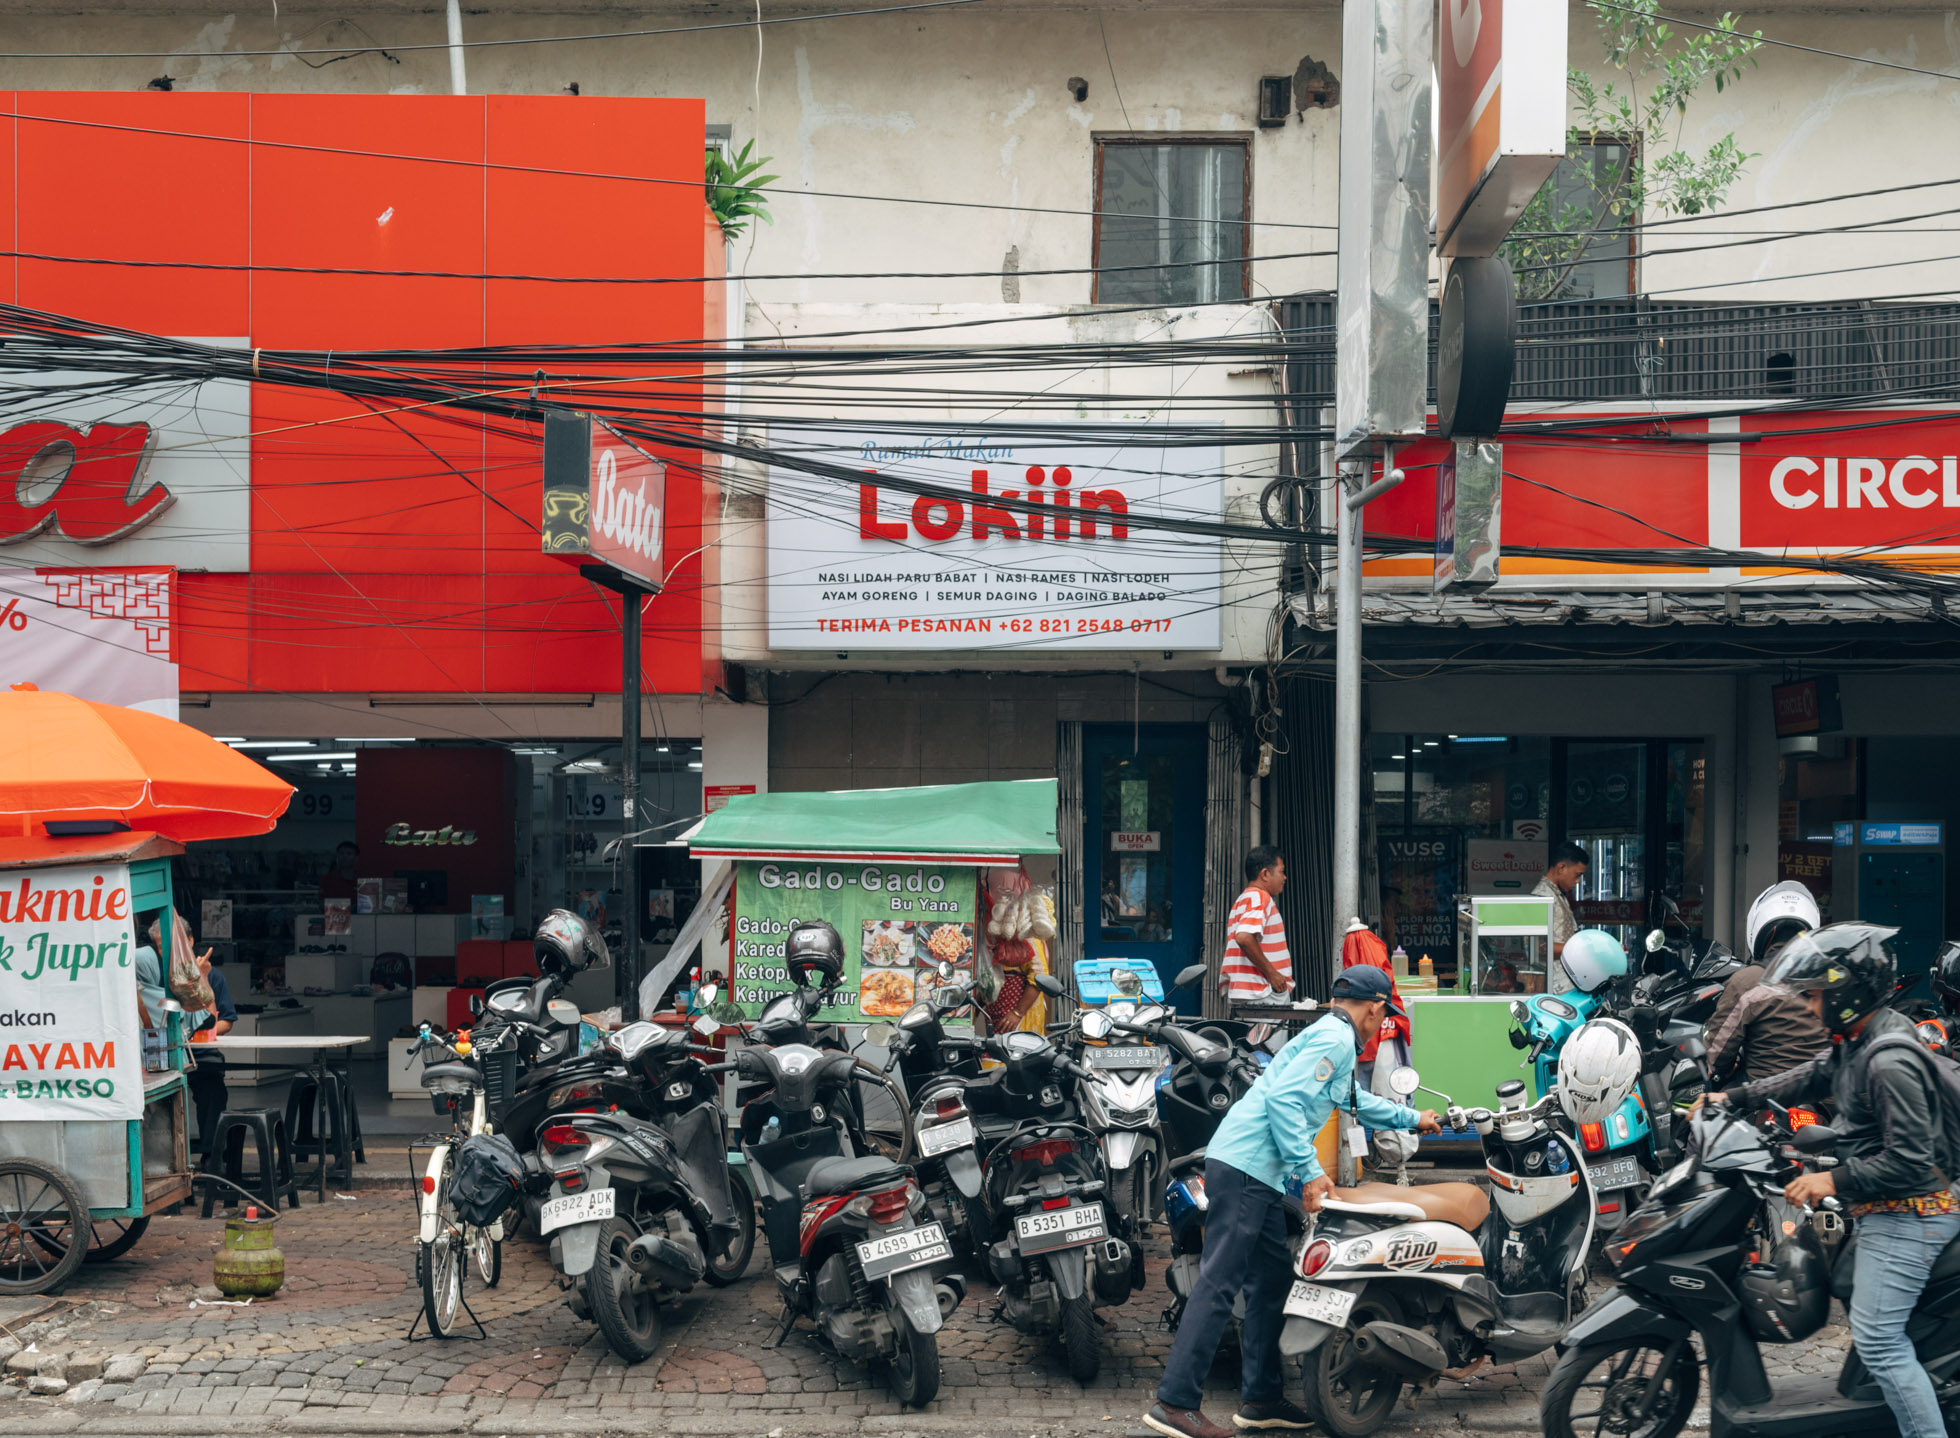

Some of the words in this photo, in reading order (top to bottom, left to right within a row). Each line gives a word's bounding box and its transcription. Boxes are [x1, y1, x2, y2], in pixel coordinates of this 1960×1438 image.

[592, 449, 662, 561] Bata
[860, 465, 1128, 541] Lokiin
[819, 573, 849, 582] NASI
[854, 573, 892, 583] LIDAH
[897, 573, 931, 583] PARU
[936, 573, 977, 582] BABAT
[996, 573, 1027, 583] NASI
[1031, 573, 1076, 583] RAMES
[1092, 573, 1122, 583] NASI
[1127, 573, 1170, 583] LODEH
[822, 591, 857, 601] AYAM
[862, 591, 918, 601] GORENG
[937, 591, 981, 601] SEMUR
[986, 591, 1038, 601] DAGING
[1057, 591, 1108, 601] DAGING
[1112, 592, 1166, 601] BALADO
[817, 619, 891, 632] TERIMA
[898, 619, 991, 632] PESANAN
[999, 619, 1032, 632] +62
[1040, 619, 1070, 632] 821
[1077, 619, 1123, 632] 2548
[1131, 619, 1172, 632] 0717
[303, 794, 333, 816] 99
[379, 822, 478, 846] Bata
[1118, 834, 1153, 843] BUKA
[1472, 860, 1508, 871] Sweet
[1510, 861, 1545, 872] Deals
[1785, 864, 1822, 877] FREE
[1795, 854, 1804, 864] 2
[1807, 855, 1832, 866] GET
[759, 864, 945, 893] Gado-Gado
[891, 897, 913, 910] Bu
[918, 898, 959, 912] Yana
[1423, 924, 1451, 934] NO.1
[21, 932, 131, 981] Jupri
[3, 1042, 115, 1070] AYAM
[1095, 1050, 1102, 1058] B
[1106, 1050, 1133, 1058] 5282
[1137, 1048, 1157, 1057] BAT
[17, 1078, 115, 1099] BAKSO
[621, 1135, 655, 1159] 125
[554, 1196, 583, 1213] 6922
[590, 1191, 612, 1205] ADK
[1021, 1221, 1029, 1235] B
[1033, 1214, 1065, 1232] 5351
[1075, 1208, 1100, 1225] BHA
[862, 1246, 871, 1260] B
[877, 1236, 909, 1256] 4699
[914, 1228, 940, 1245] TEK
[1387, 1237, 1439, 1263] Fino
[1291, 1284, 1321, 1302] 3259
[1327, 1291, 1351, 1309] SJY
